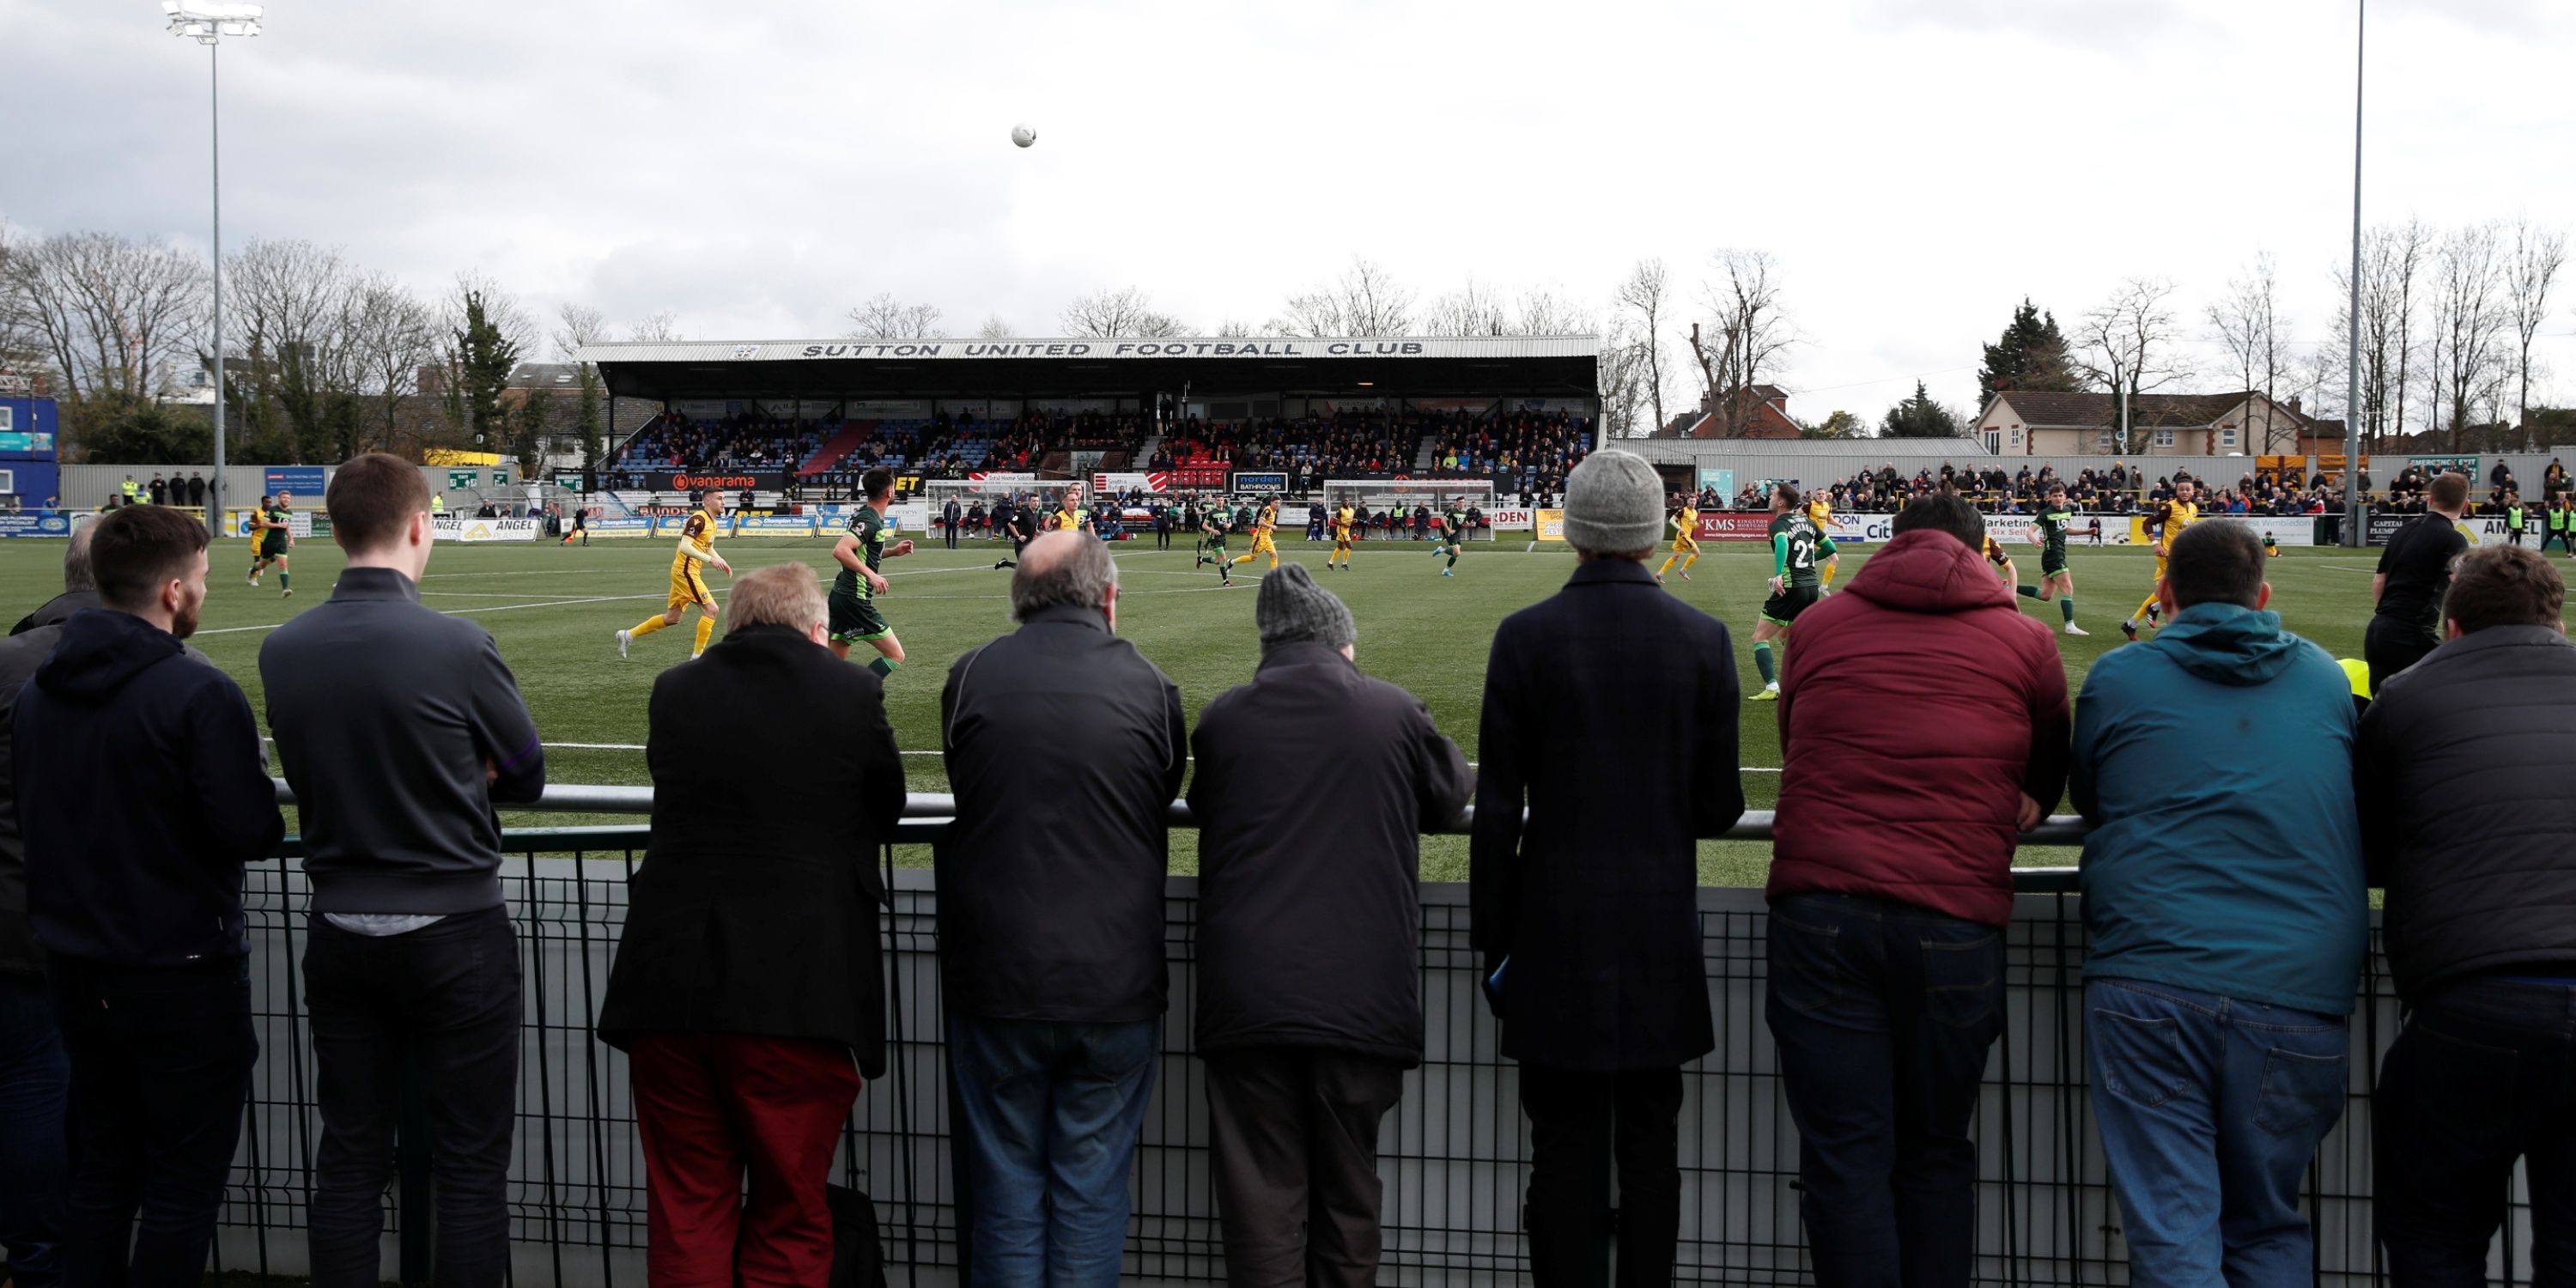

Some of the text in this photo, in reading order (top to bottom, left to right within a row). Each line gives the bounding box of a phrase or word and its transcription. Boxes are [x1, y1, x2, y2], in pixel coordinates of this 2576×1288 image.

[802, 343, 1423, 356] SUTTON UNITED FOOTBALL CLUB
[690, 477, 756, 487] vanarama
[895, 477, 920, 490] ET
[495, 519, 533, 530] ANGEL
[1704, 519, 1735, 531] KMS
[2261, 519, 2311, 527] Wimbledon
[2483, 520, 2540, 534] ANEL
[1794, 538, 1815, 568] 21
